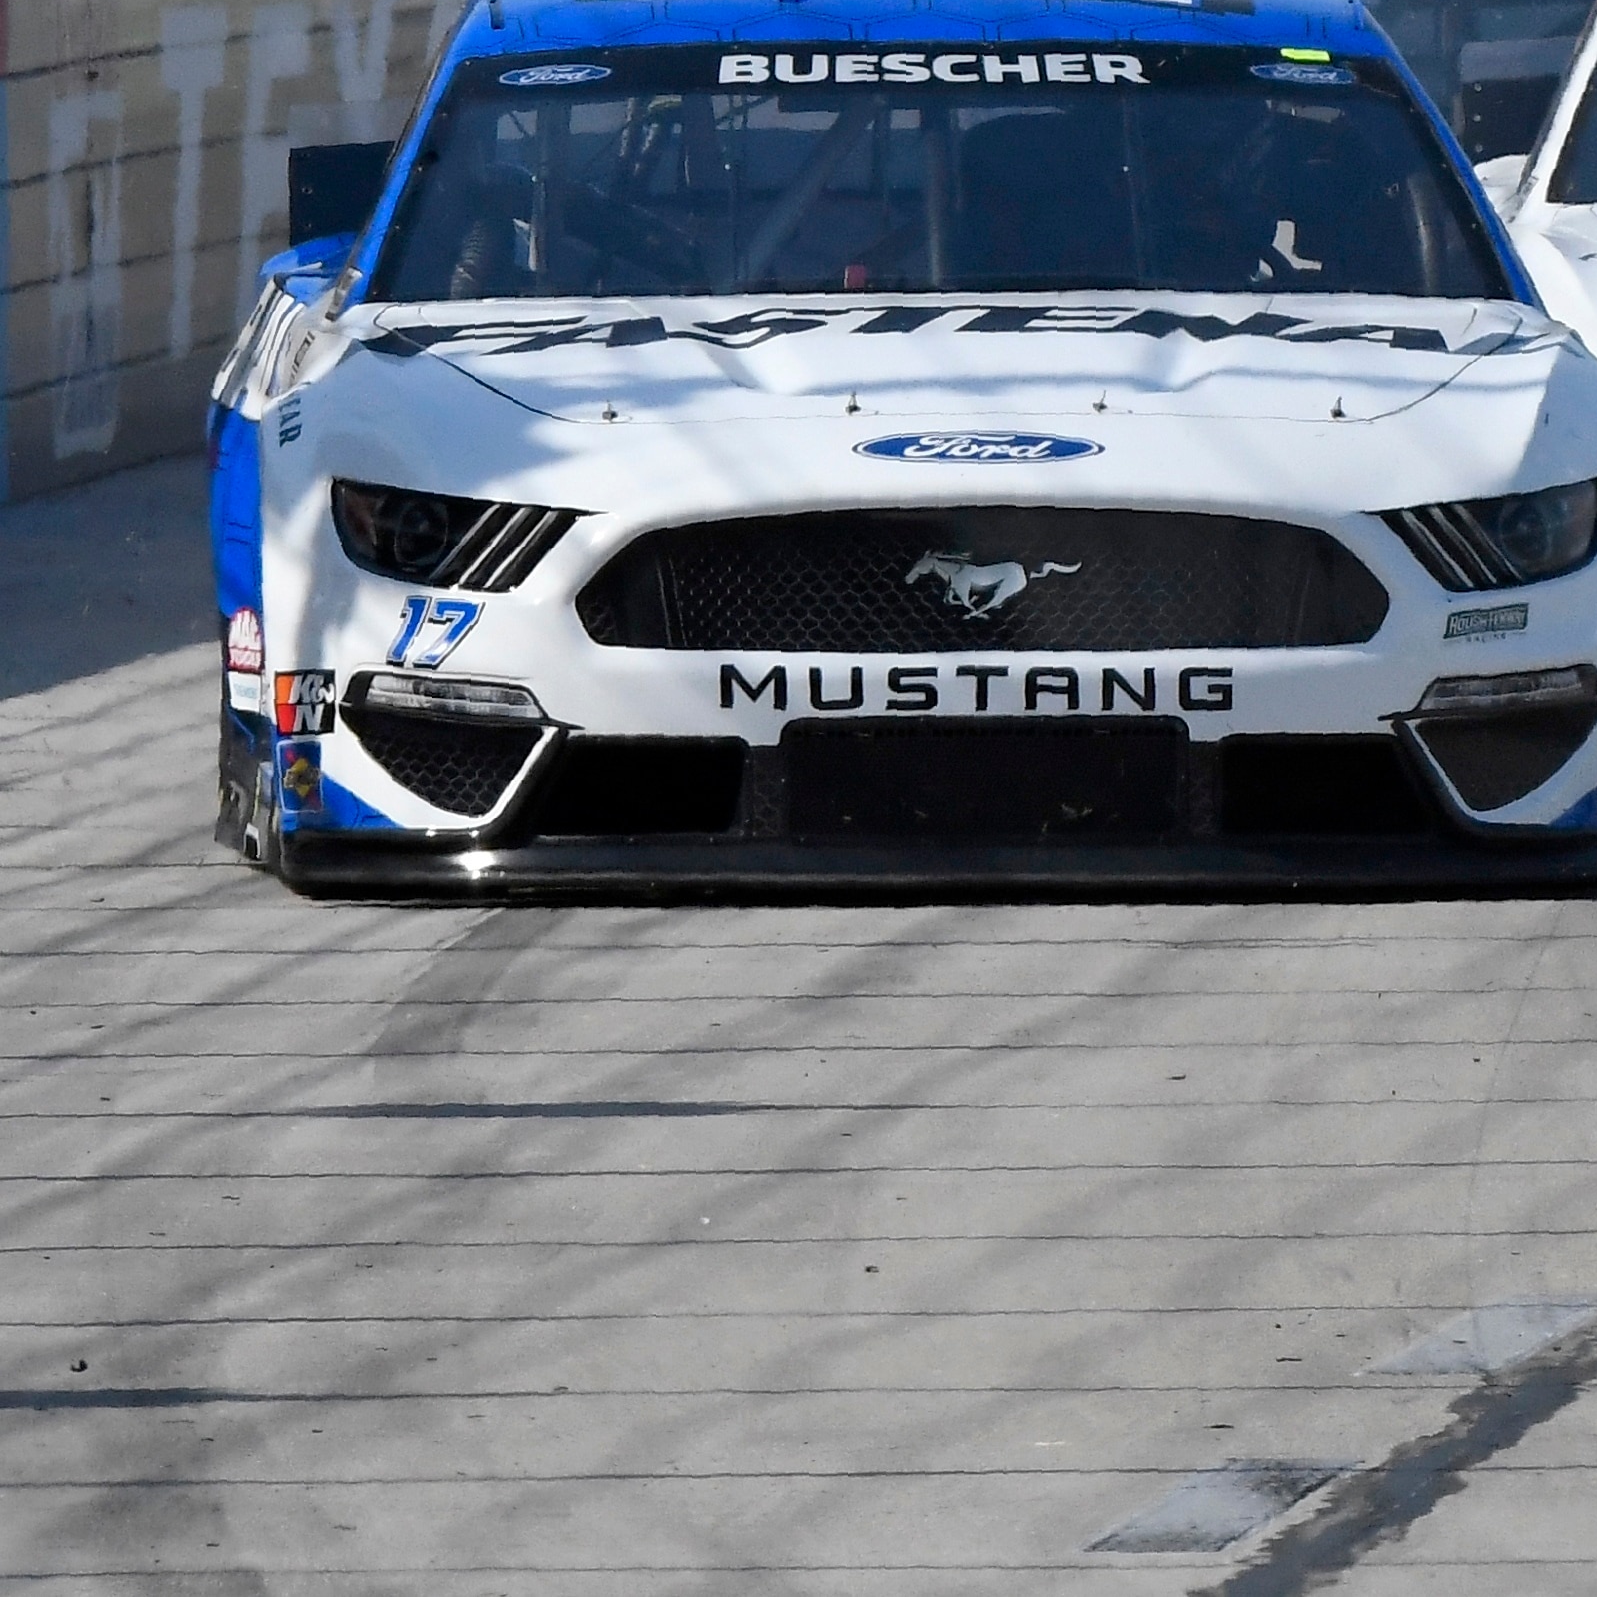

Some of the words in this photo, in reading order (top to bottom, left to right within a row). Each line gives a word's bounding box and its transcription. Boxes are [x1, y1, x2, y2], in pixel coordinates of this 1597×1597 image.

[718, 53, 1151, 85] BUESCHER
[386, 595, 486, 670] 17
[719, 664, 1234, 711] MUSTANG
